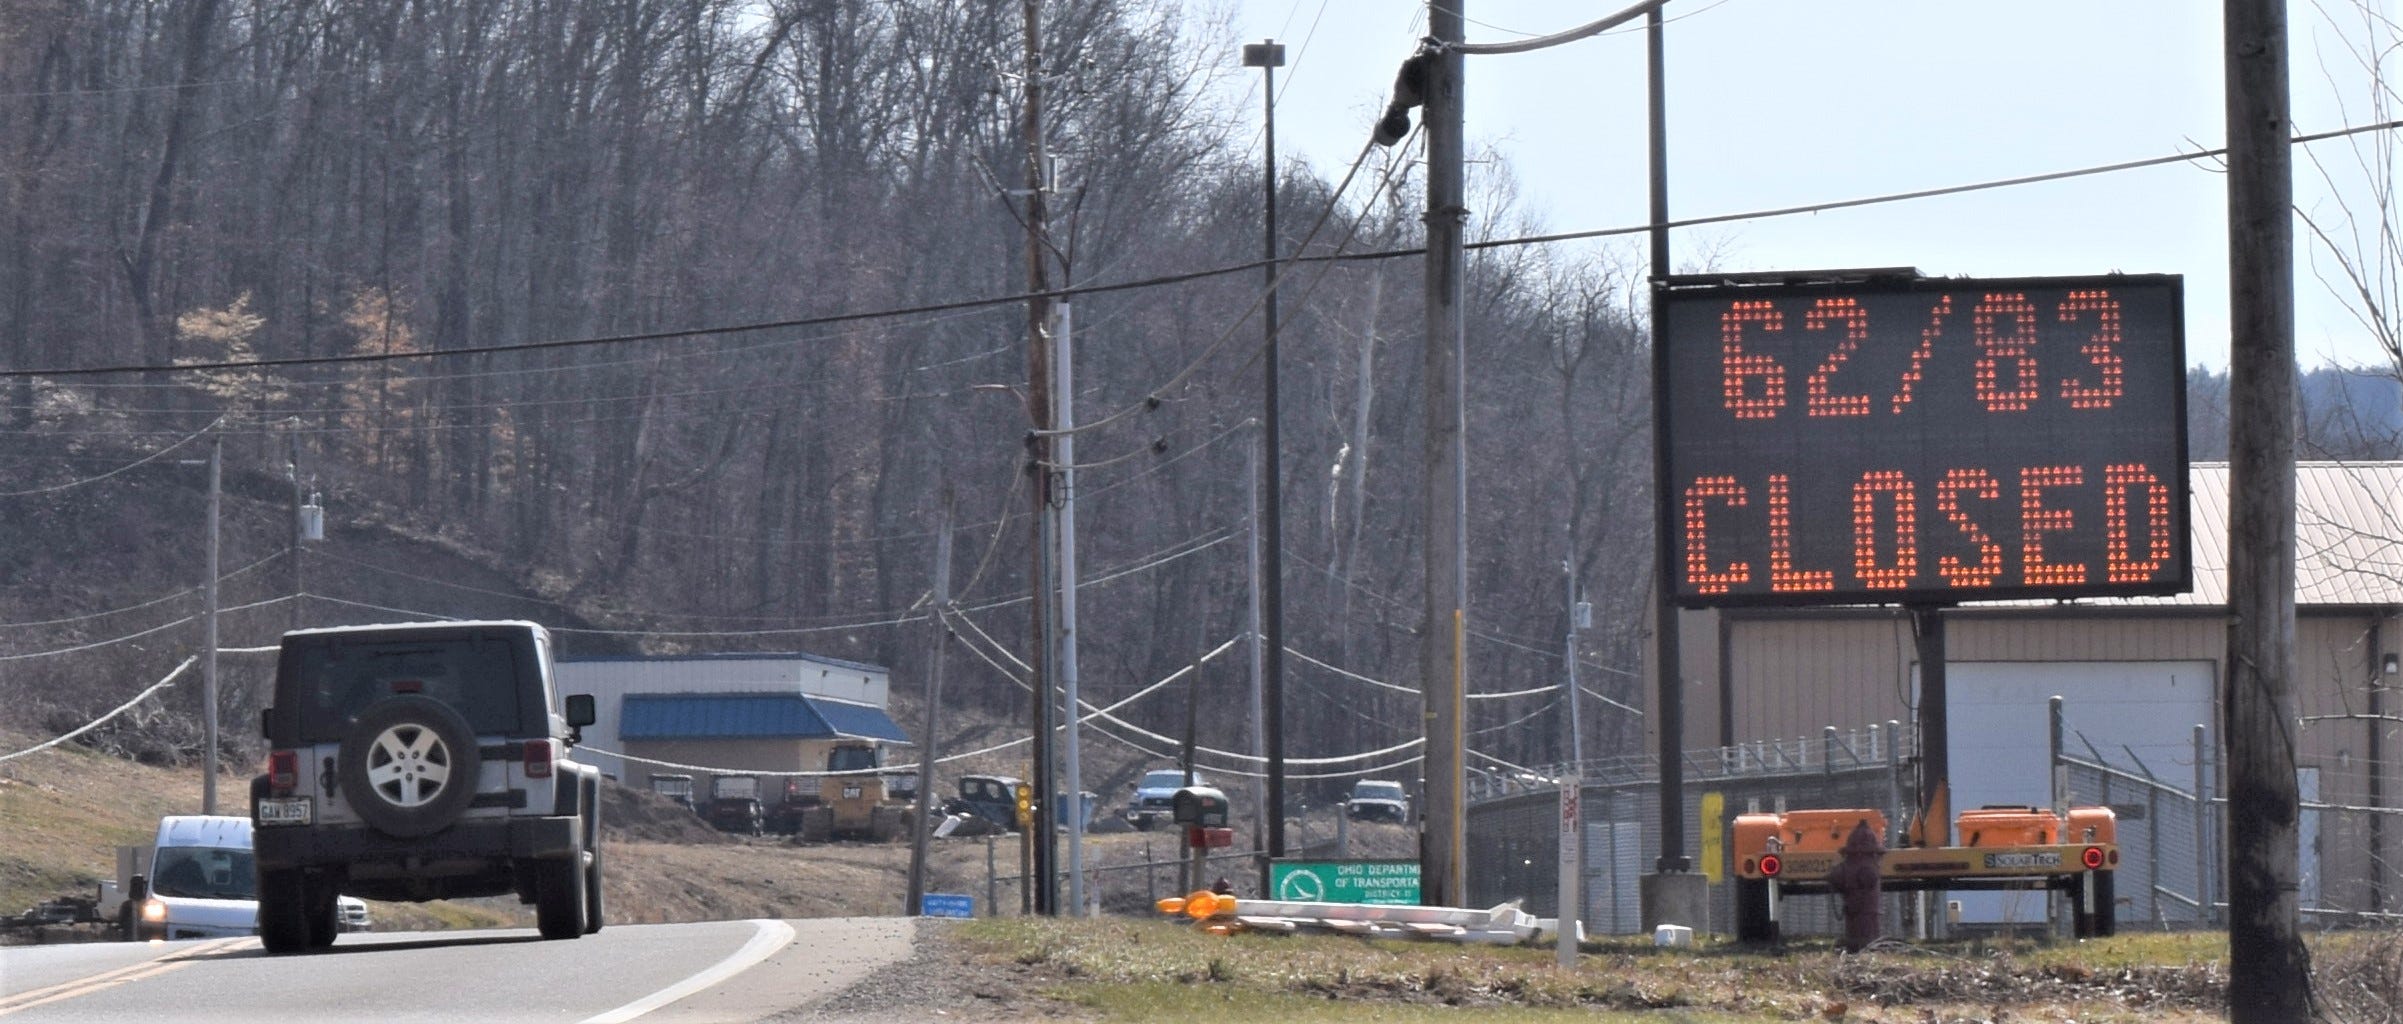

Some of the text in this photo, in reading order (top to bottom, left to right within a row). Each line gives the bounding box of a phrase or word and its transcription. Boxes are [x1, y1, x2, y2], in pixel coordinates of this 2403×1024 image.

[1722, 290, 2123, 419] 62/83
[1685, 463, 2170, 594] CLOSED
[844, 788, 861, 799] CAT
[1337, 864, 1363, 875] OHIO
[1335, 878, 1348, 888] OF
